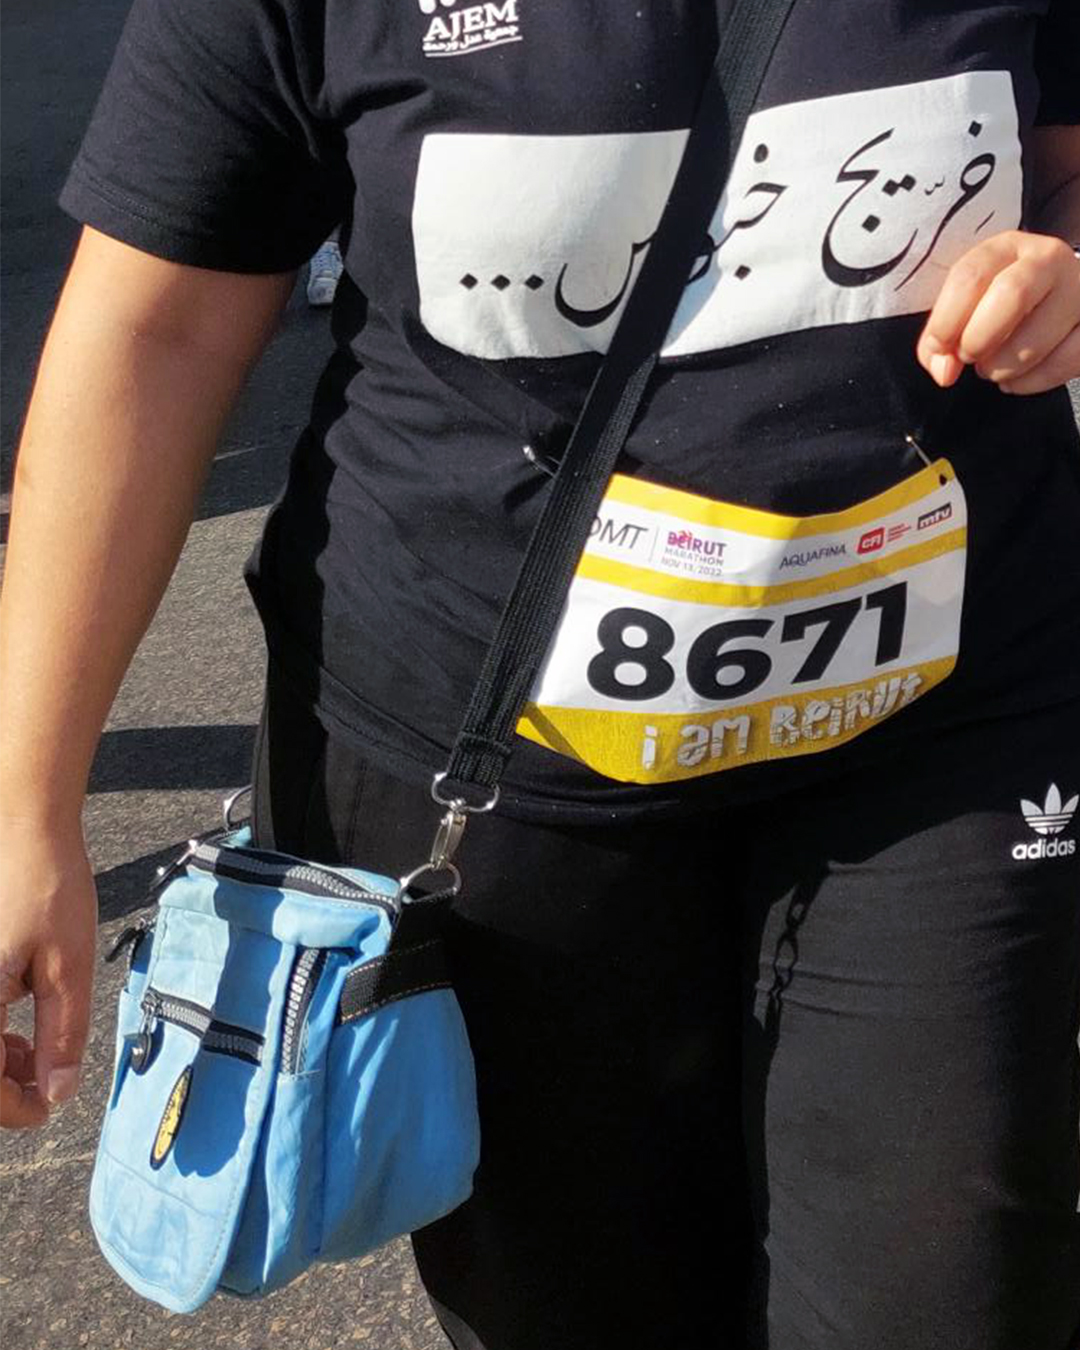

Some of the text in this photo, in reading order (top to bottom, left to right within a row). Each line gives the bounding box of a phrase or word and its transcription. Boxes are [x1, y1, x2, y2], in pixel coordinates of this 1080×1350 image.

[664, 546, 725, 567] MARATHON
[667, 529, 728, 558] BEIRUT
[779, 543, 847, 570] AQUAFINA
[586, 581, 908, 701] 8671
[1011, 837, 1077, 861] adidas
